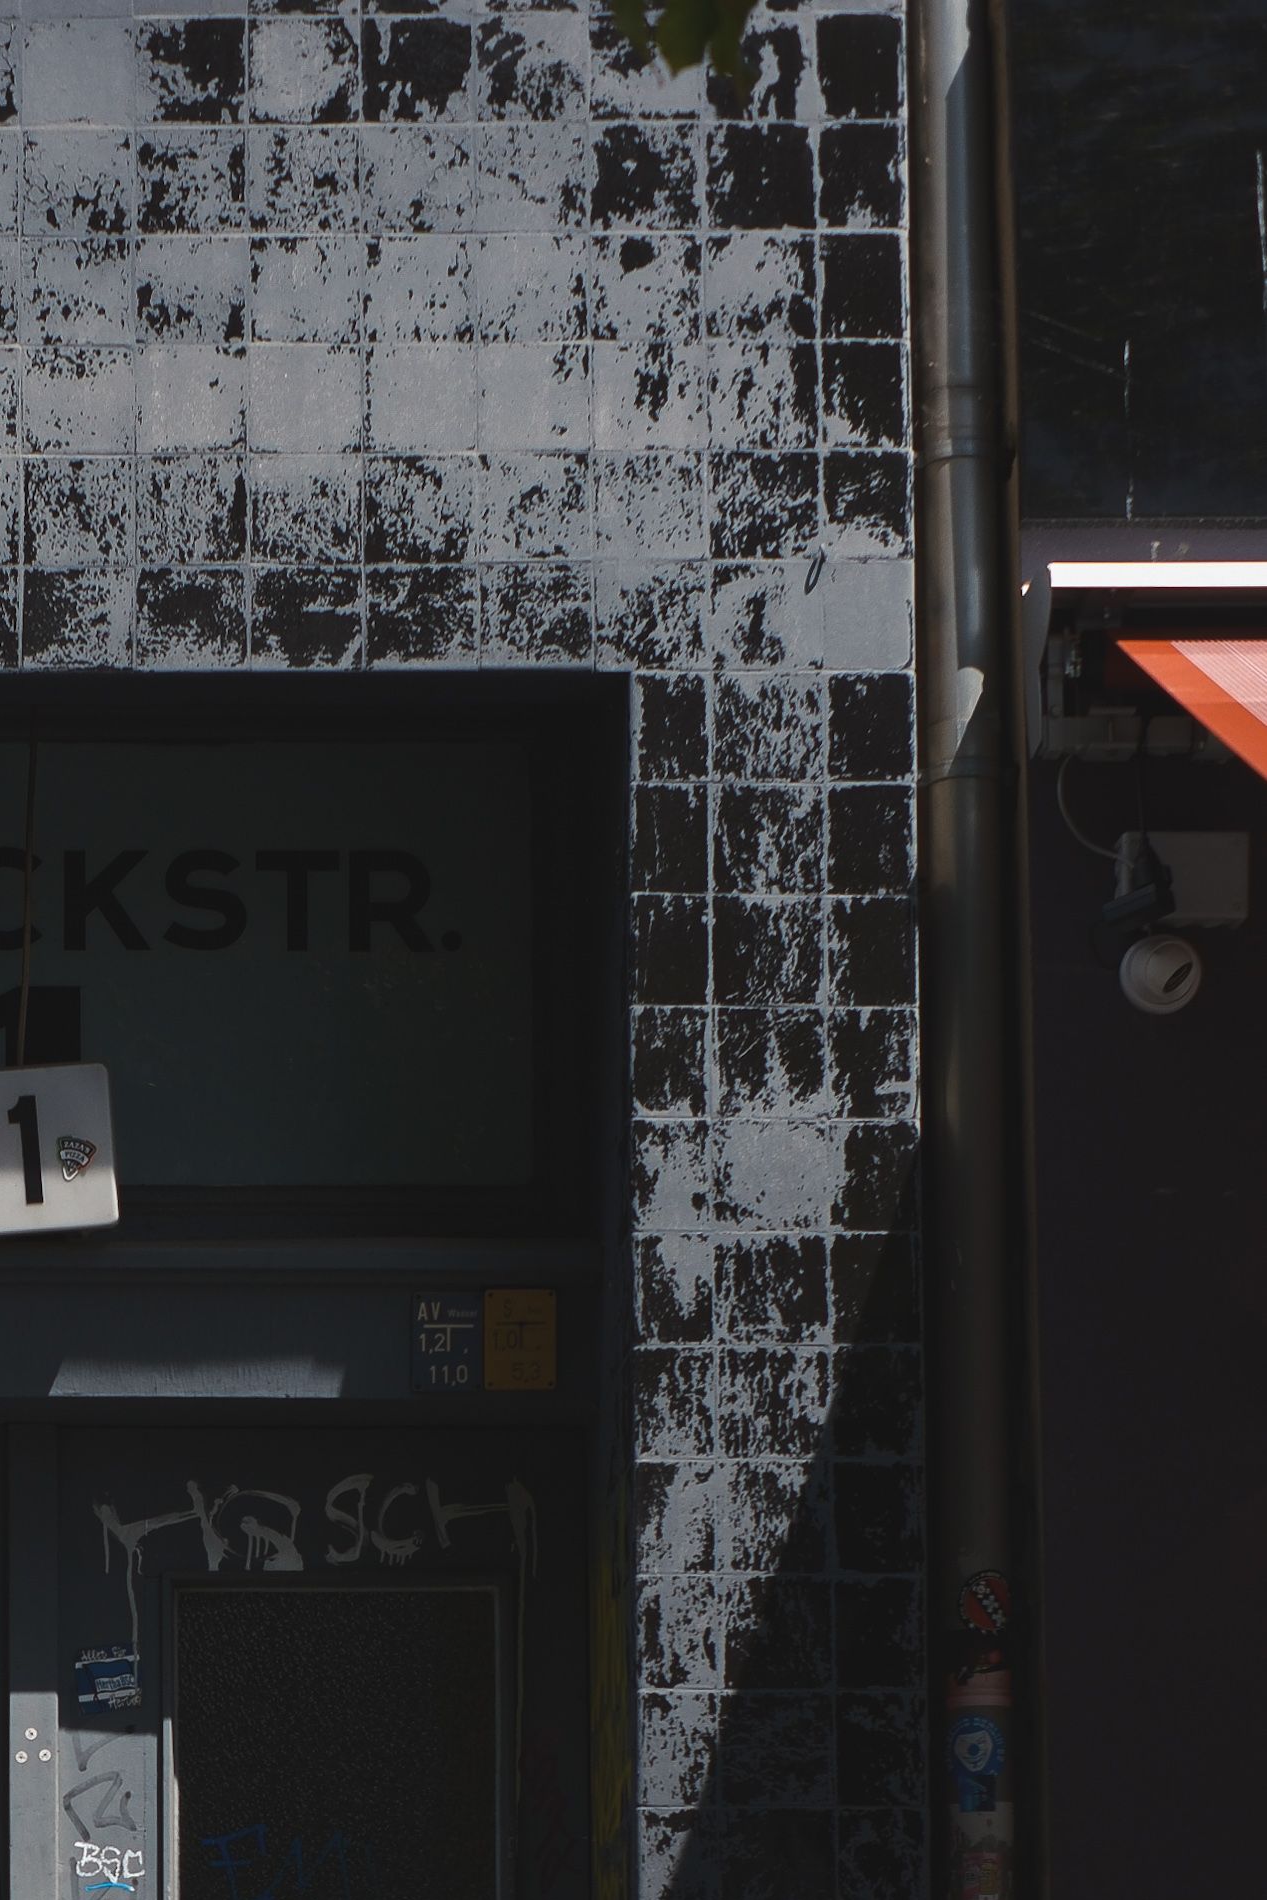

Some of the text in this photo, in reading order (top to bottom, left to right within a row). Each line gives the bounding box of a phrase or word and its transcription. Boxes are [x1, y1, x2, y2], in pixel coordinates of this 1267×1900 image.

[7, 1094, 44, 1205] 1
[416, 1301, 441, 1322] AV
[428, 1364, 469, 1387] 11,0
